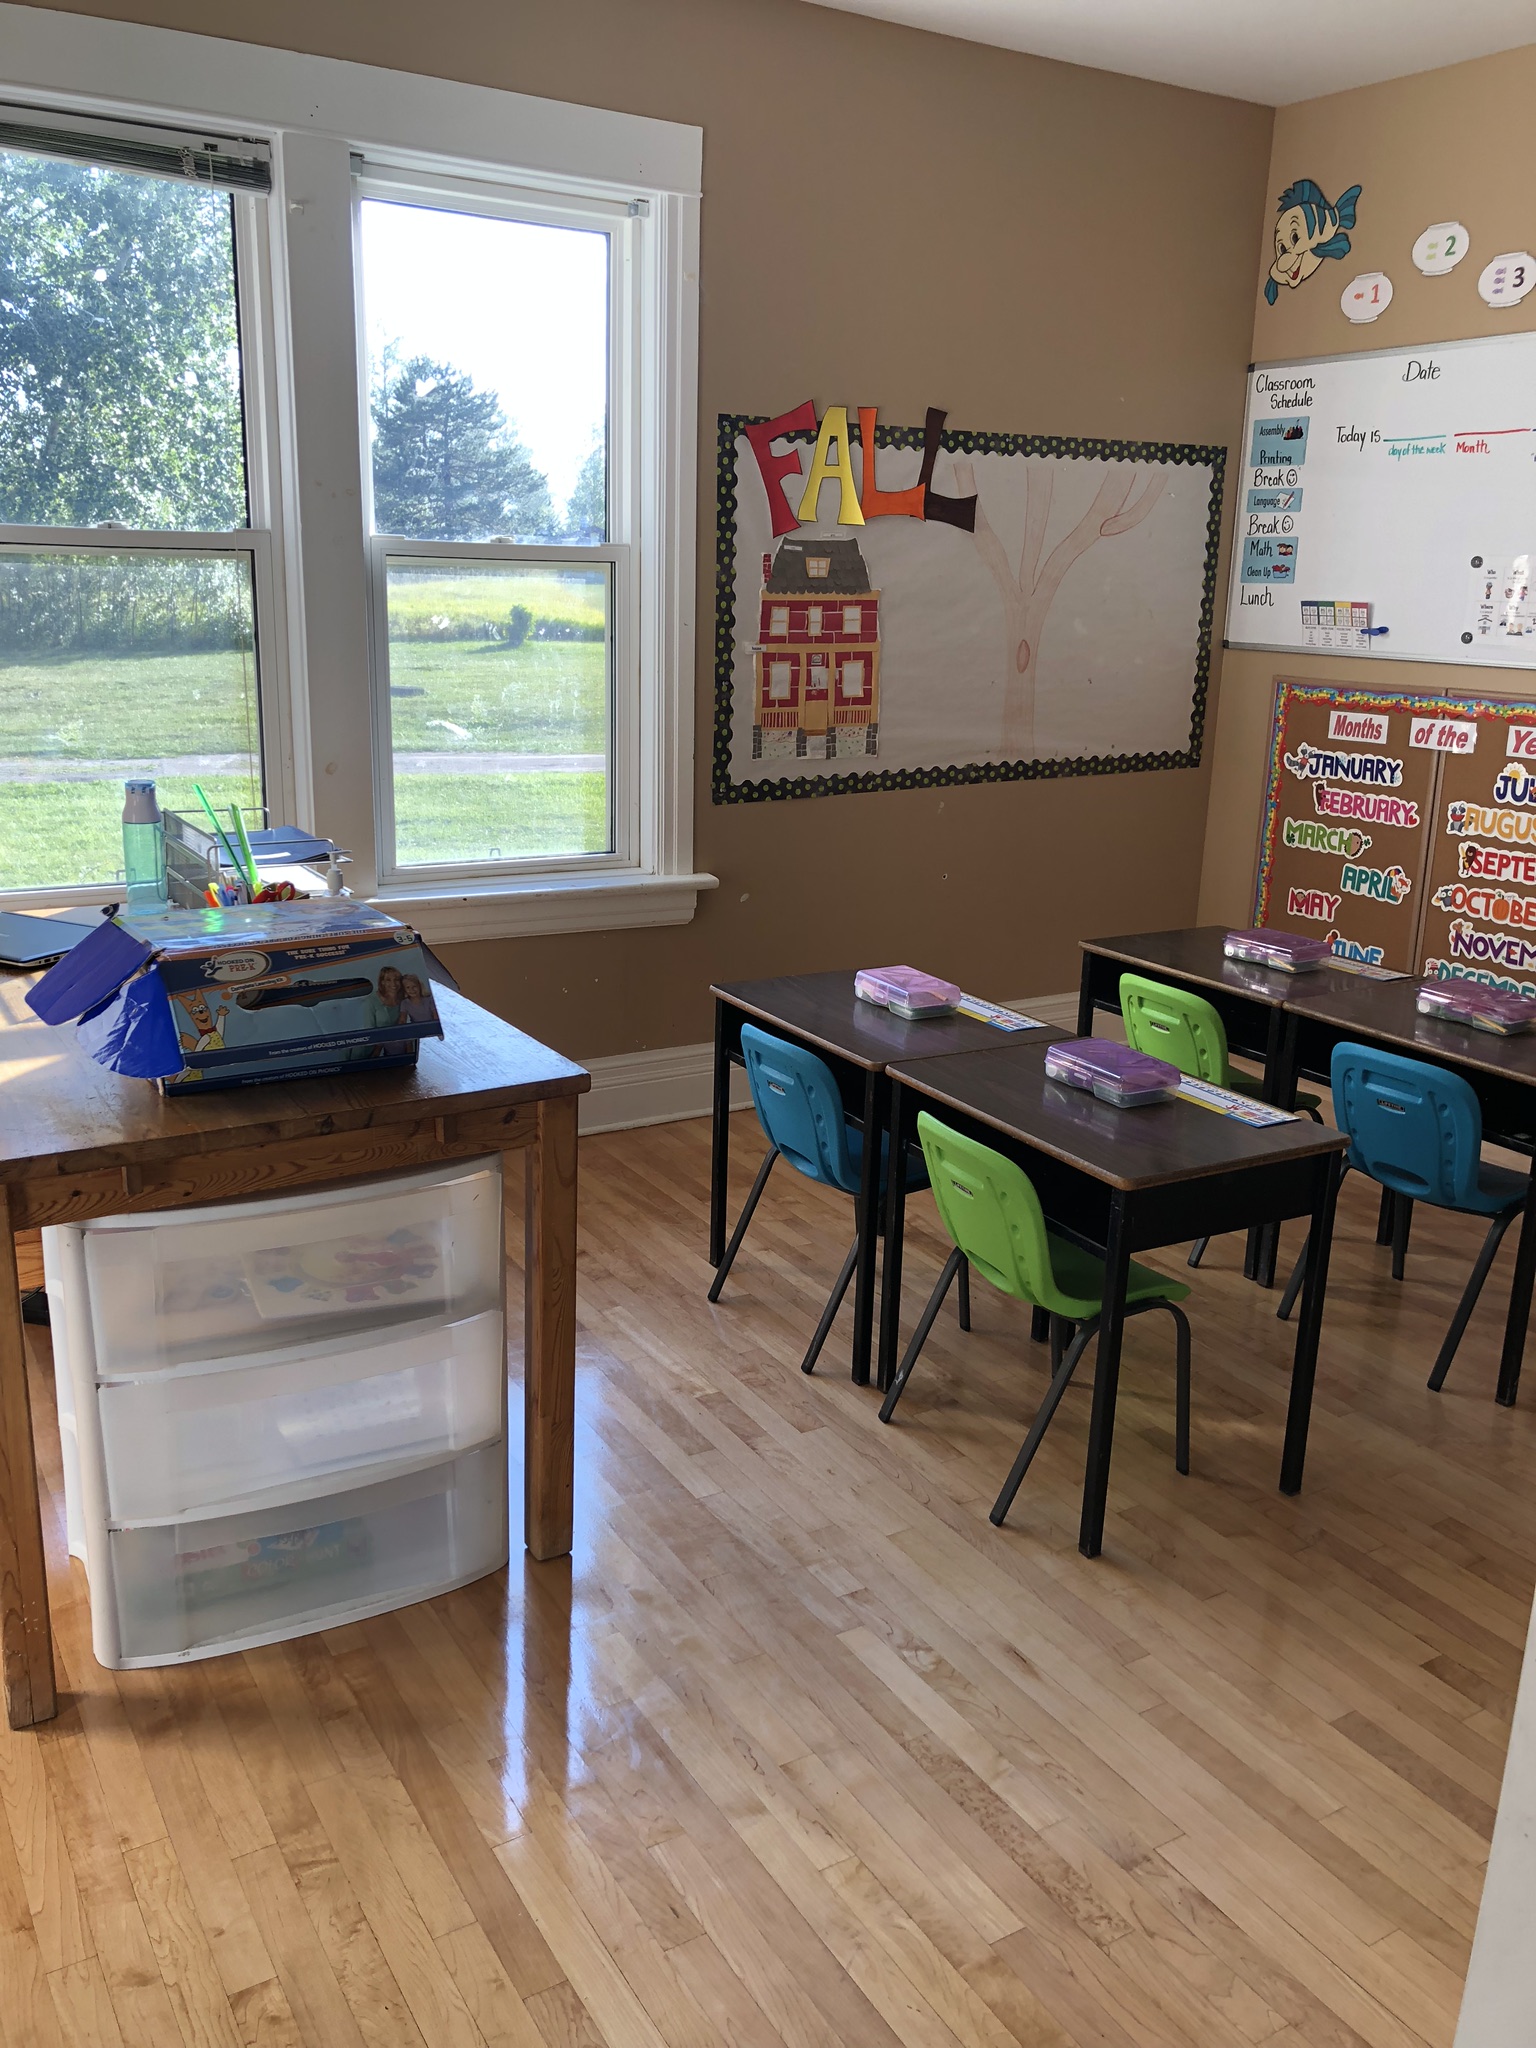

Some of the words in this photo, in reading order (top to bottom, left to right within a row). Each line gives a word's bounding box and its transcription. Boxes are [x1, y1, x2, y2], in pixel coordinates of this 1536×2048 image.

[1444, 236, 1457, 257] 2
[1512, 266, 1525, 288] 3
[1370, 284, 1381, 304] 1
[1402, 360, 1441, 382] Date
[1256, 373, 1316, 393] Classroom
[1270, 391, 1313, 409] Schedule
[1259, 424, 1286, 437] Assembly
[1336, 425, 1367, 452] Today
[1370, 430, 1381, 443] is
[1260, 449, 1292, 465] Printing
[1388, 444, 1402, 461] day
[1402, 443, 1411, 455] of
[1412, 444, 1425, 455] the
[1426, 442, 1447, 454] week
[1455, 439, 1491, 454] Month
[744, 399, 978, 539] FALL
[1254, 468, 1285, 487] Break
[1254, 495, 1281, 508] Language
[1247, 514, 1281, 535] Break
[1250, 540, 1273, 557] Math
[1247, 566, 1262, 577] Clean
[1263, 567, 1271, 579] Up
[1240, 585, 1274, 607] Lunch
[1333, 714, 1383, 740] Months
[1414, 723, 1436, 745] of
[1437, 724, 1469, 749] the
[1512, 729, 1536, 755] Ye
[1308, 753, 1401, 784] JANUARY
[1319, 789, 1416, 826] FEBRUARY
[1285, 820, 1353, 856] MARCH
[1470, 850, 1536, 882] SEPTE
[1341, 865, 1399, 902] APRIL
[1288, 889, 1340, 920] MAY
[1450, 886, 1536, 927] OCTOBE
[1453, 931, 1536, 967] NOVEM
[229, 963, 256, 973] PRE-K
